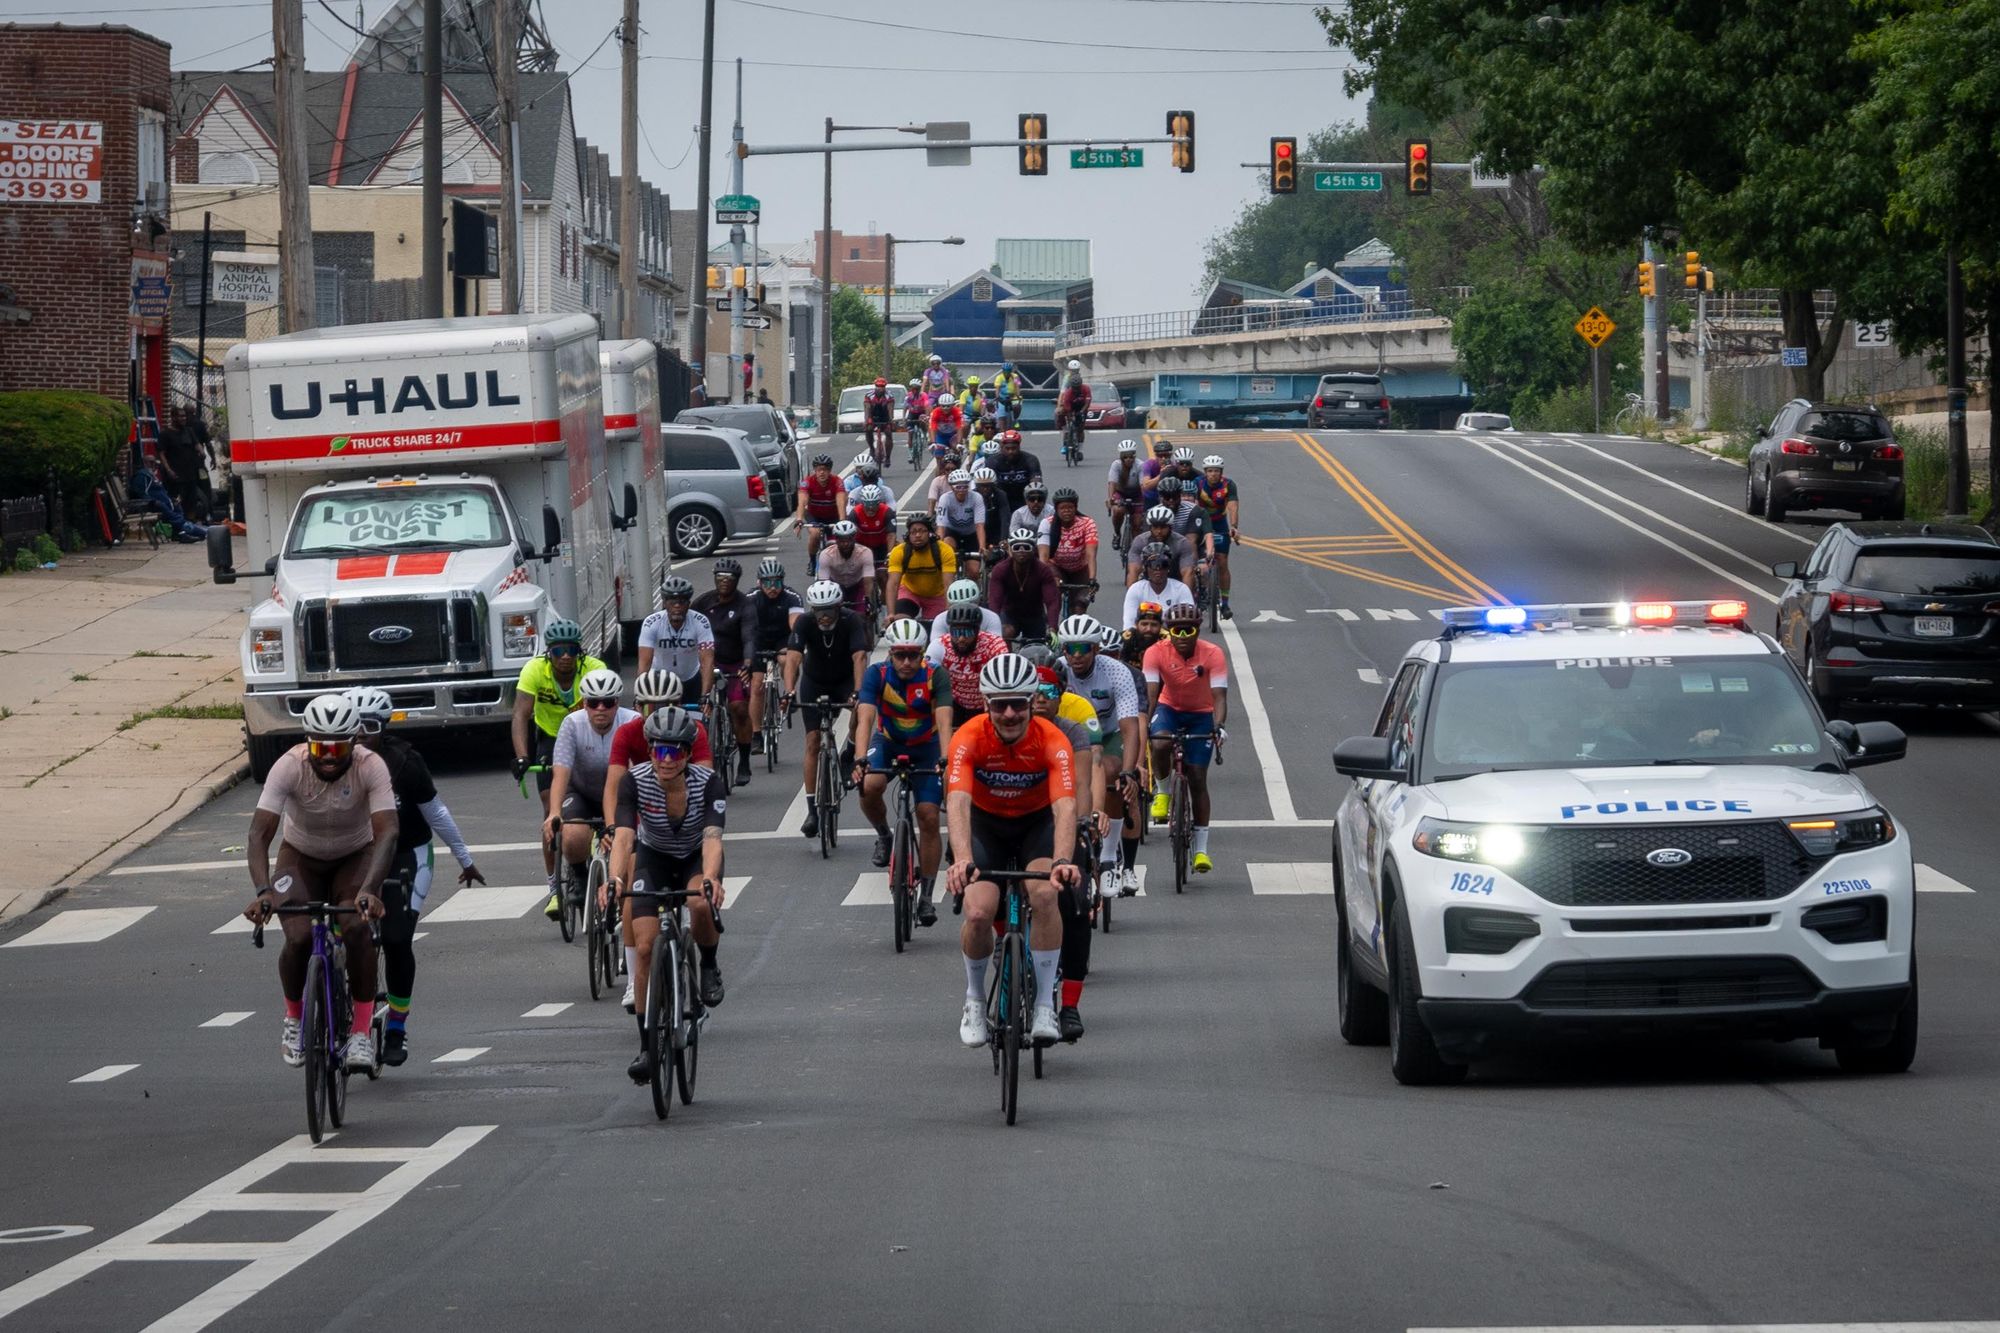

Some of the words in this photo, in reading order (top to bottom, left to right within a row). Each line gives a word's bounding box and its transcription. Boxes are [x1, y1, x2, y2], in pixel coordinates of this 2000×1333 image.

[15, 122, 97, 140] SEAL
[12, 145, 94, 162] DOORS
[1077, 152, 1114, 164] 45th
[1120, 152, 1136, 162] St
[1322, 175, 1355, 187] 45th
[1361, 175, 1375, 187] St
[226, 263, 267, 275] ONEAL
[221, 273, 270, 284] ANIMAL
[218, 282, 273, 294] HOSPITAL
[1858, 325, 1888, 342] 25
[269, 370, 520, 420] U-HAUL
[351, 435, 391, 449] TRUCK
[393, 433, 433, 446] SHARE
[435, 432, 462, 445] 24/7
[323, 500, 467, 527] LOWEST
[348, 520, 442, 542] COST
[378, 628, 404, 640] Ford
[660, 636, 697, 648] mtcc
[1555, 656, 1674, 670] POLICE
[955, 745, 967, 777] PISSEI
[1062, 755, 1072, 789] PISSEI
[1561, 800, 1752, 819] POLICE
[1655, 849, 1684, 866] Ford
[1450, 871, 1495, 896] 1624
[1823, 879, 1872, 896] 225108
